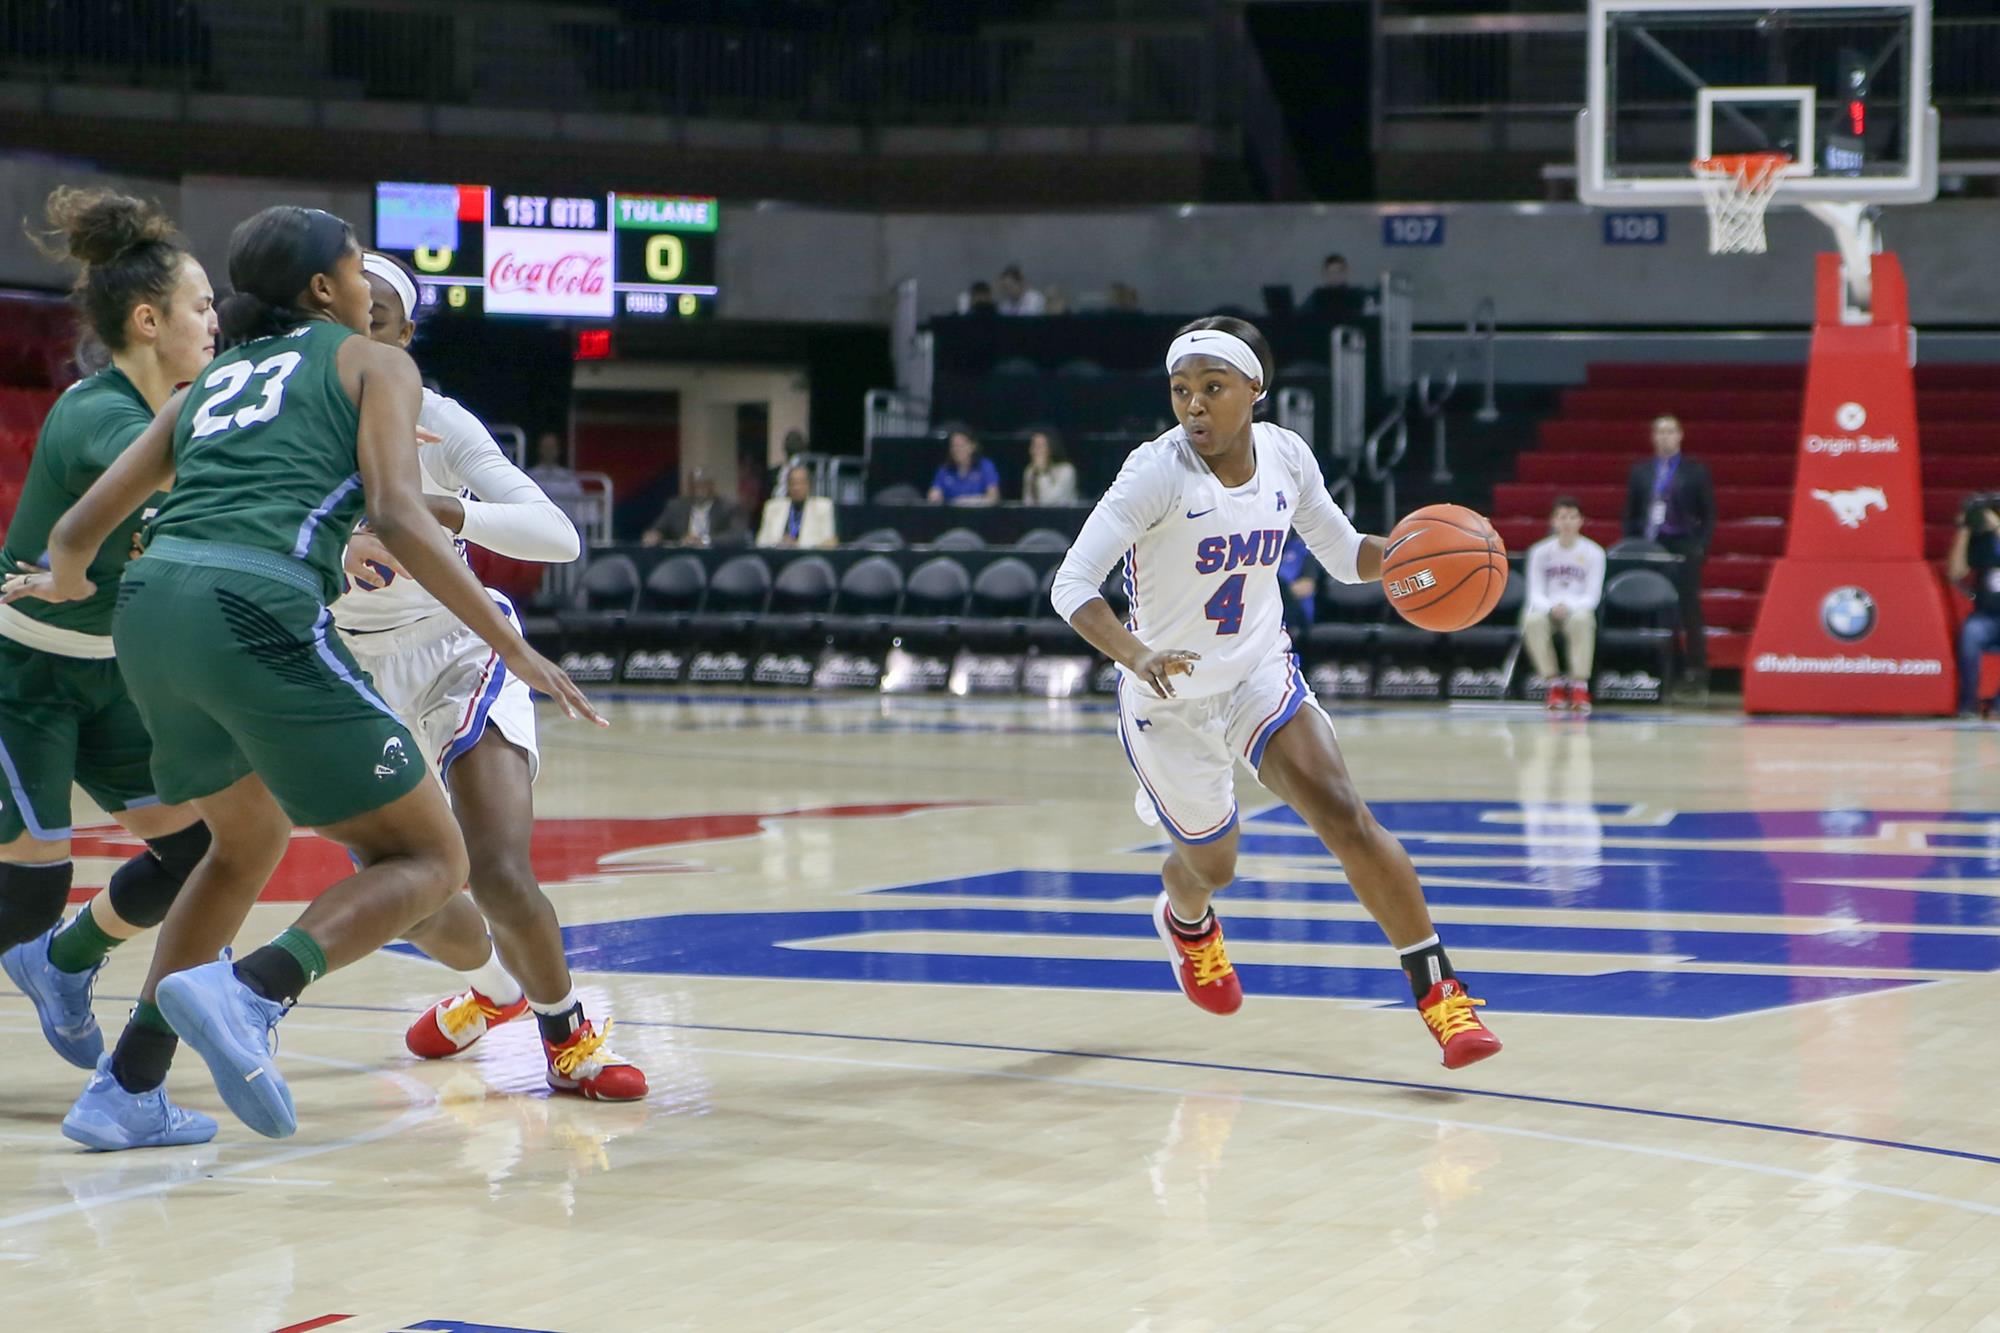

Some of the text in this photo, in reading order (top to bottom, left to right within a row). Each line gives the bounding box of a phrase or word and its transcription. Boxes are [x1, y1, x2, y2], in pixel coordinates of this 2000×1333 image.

[503, 195, 596, 228] 1ST QTR
[620, 199, 709, 224] TULANE
[1392, 217, 1438, 241] 107
[1611, 217, 1659, 241] 108
[646, 234, 683, 281] 0
[191, 350, 302, 440] 23
[1805, 434, 1900, 456] Origin Bank
[1195, 529, 1284, 575] SMU
[1389, 568, 1437, 599] ELITE
[1204, 573, 1248, 636] 4
[1755, 652, 1943, 675] dfwbmwdealers.com
